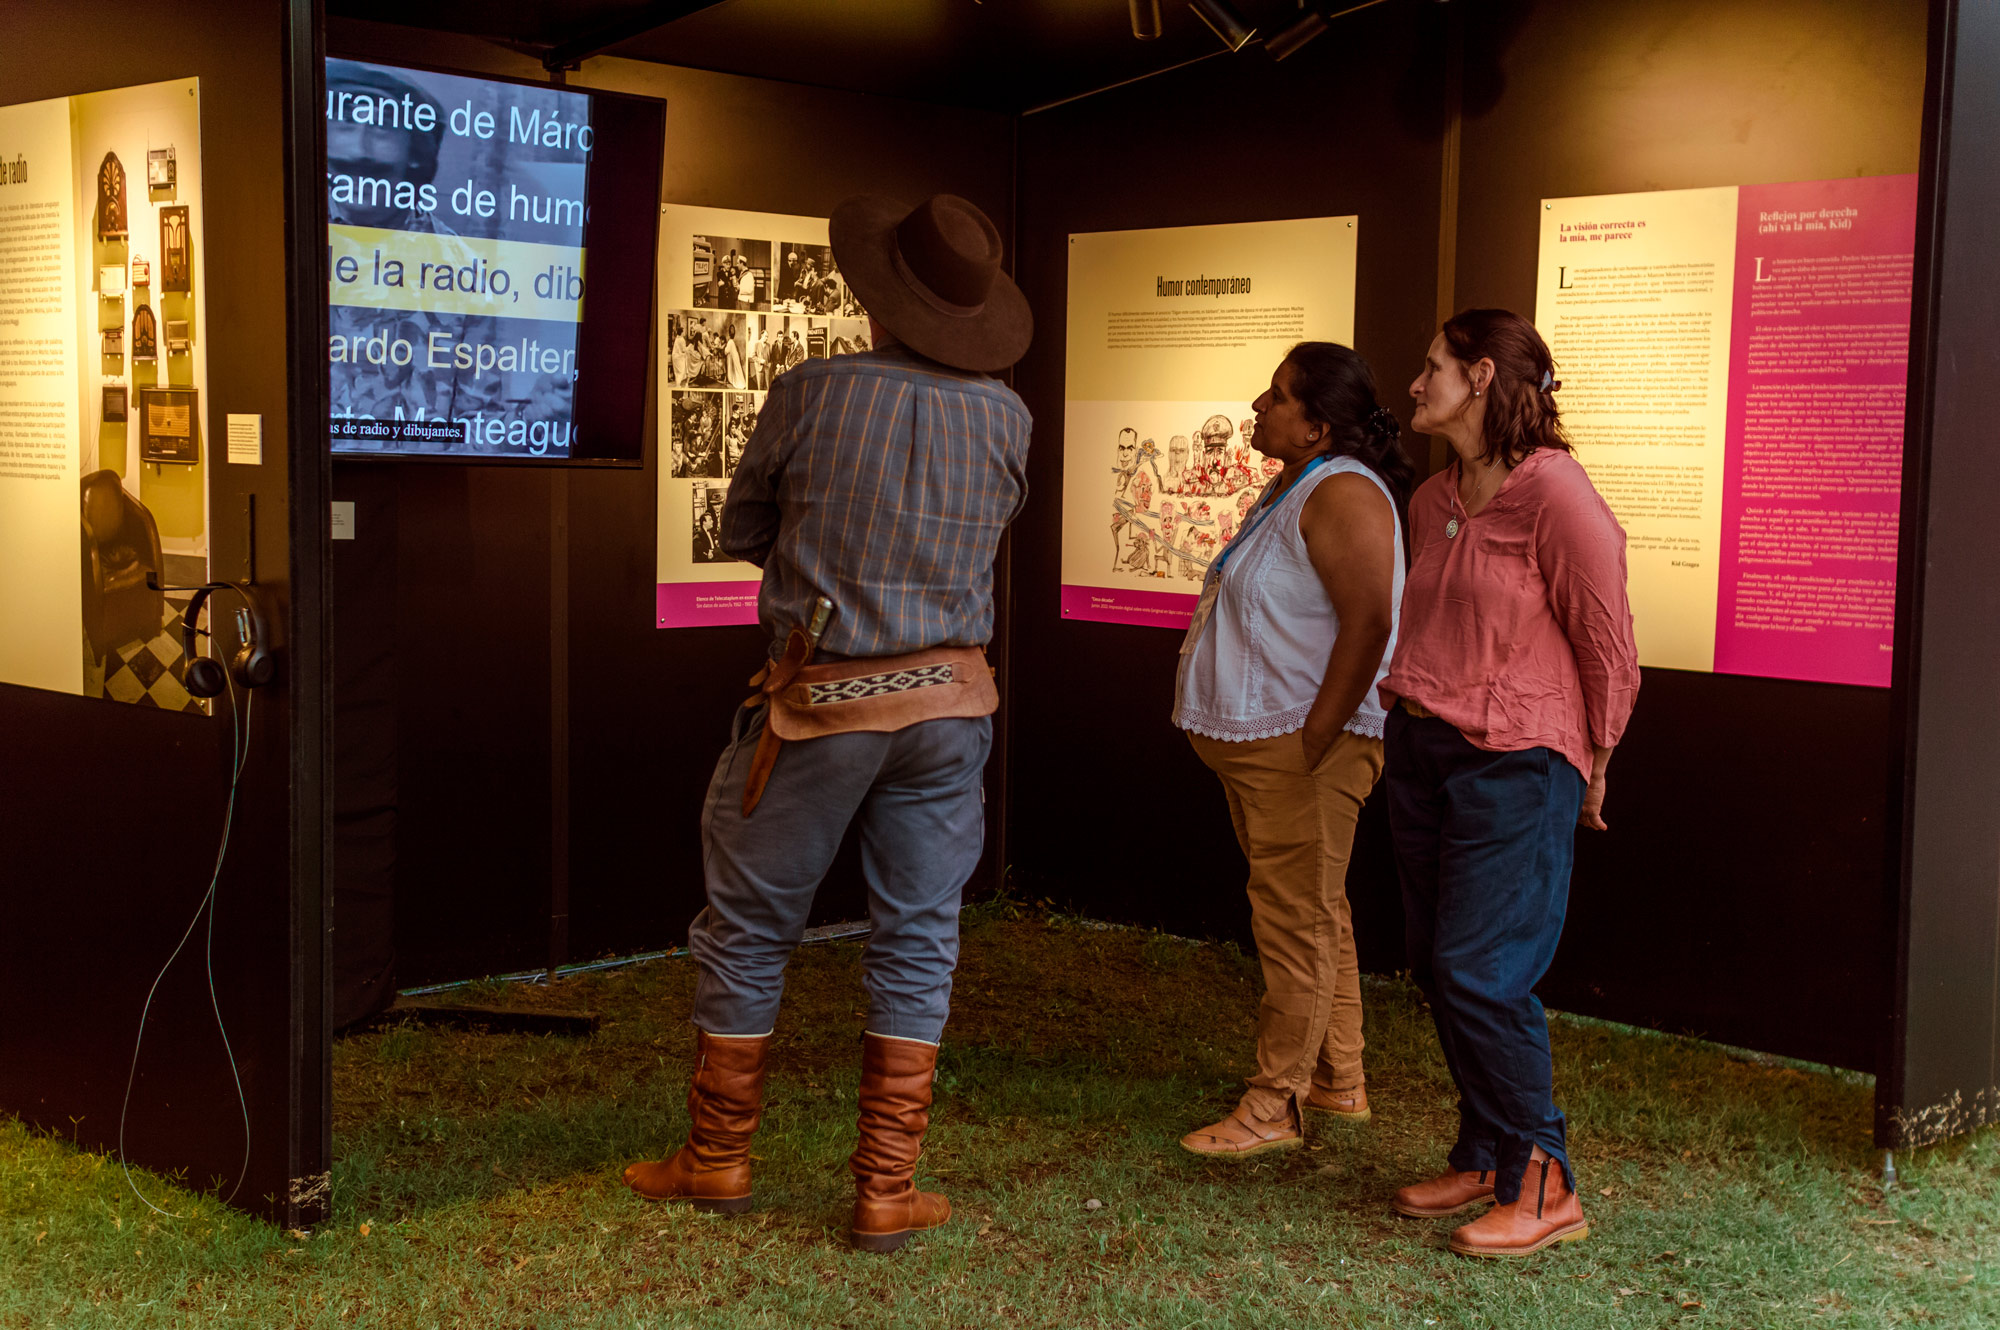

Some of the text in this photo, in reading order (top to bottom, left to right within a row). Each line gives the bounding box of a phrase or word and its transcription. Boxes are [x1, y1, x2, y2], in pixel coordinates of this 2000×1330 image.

[450, 100, 496, 139] de
[9, 153, 28, 184] radio
[451, 180, 496, 218] de
[510, 184, 591, 227] hum
[1760, 207, 1858, 222] Reflejos por derecha
[1560, 224, 1571, 232] La
[1574, 222, 1598, 231] visión
[1600, 220, 1635, 229] correcta
[1560, 234, 1567, 242] la
[1570, 232, 1587, 242] mía,
[1605, 232, 1632, 243] parece
[1780, 224, 1791, 232] va
[1794, 221, 1802, 231] la
[1830, 219, 1852, 230] Kid)
[374, 249, 404, 288] la
[420, 259, 519, 303] radio,
[534, 264, 586, 300] dib
[1157, 274, 1250, 298] Humor contemporáneo
[330, 328, 580, 380] ardo Espalter,
[343, 422, 357, 434] de
[360, 422, 390, 435] radio
[392, 426, 400, 439] y
[403, 424, 463, 440] dibujantes.
[395, 406, 579, 456] nteagu
